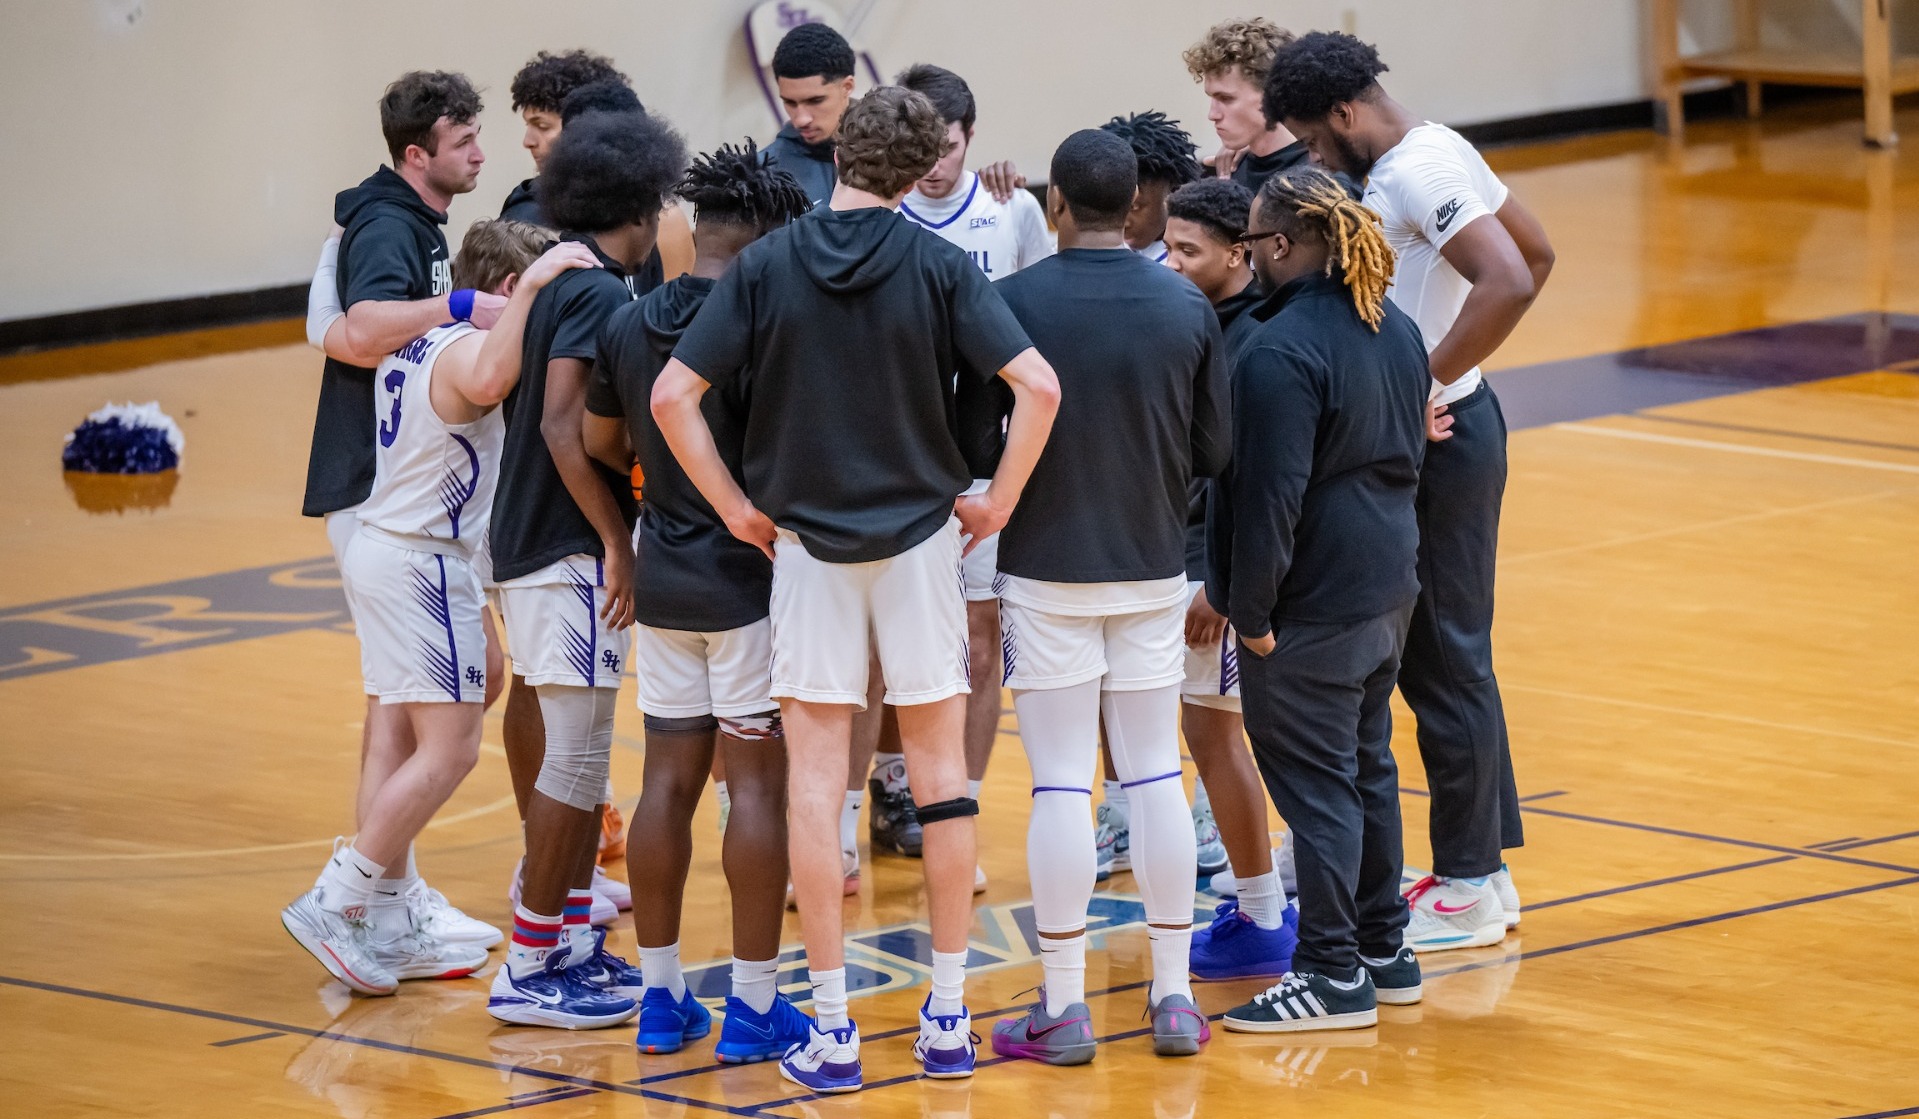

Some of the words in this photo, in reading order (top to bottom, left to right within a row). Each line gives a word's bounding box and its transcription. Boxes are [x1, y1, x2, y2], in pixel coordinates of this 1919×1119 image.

[1435, 198, 1457, 222] NIKE
[379, 369, 406, 449] 3
[601, 649, 621, 673] SHC
[465, 665, 485, 688] SHC
